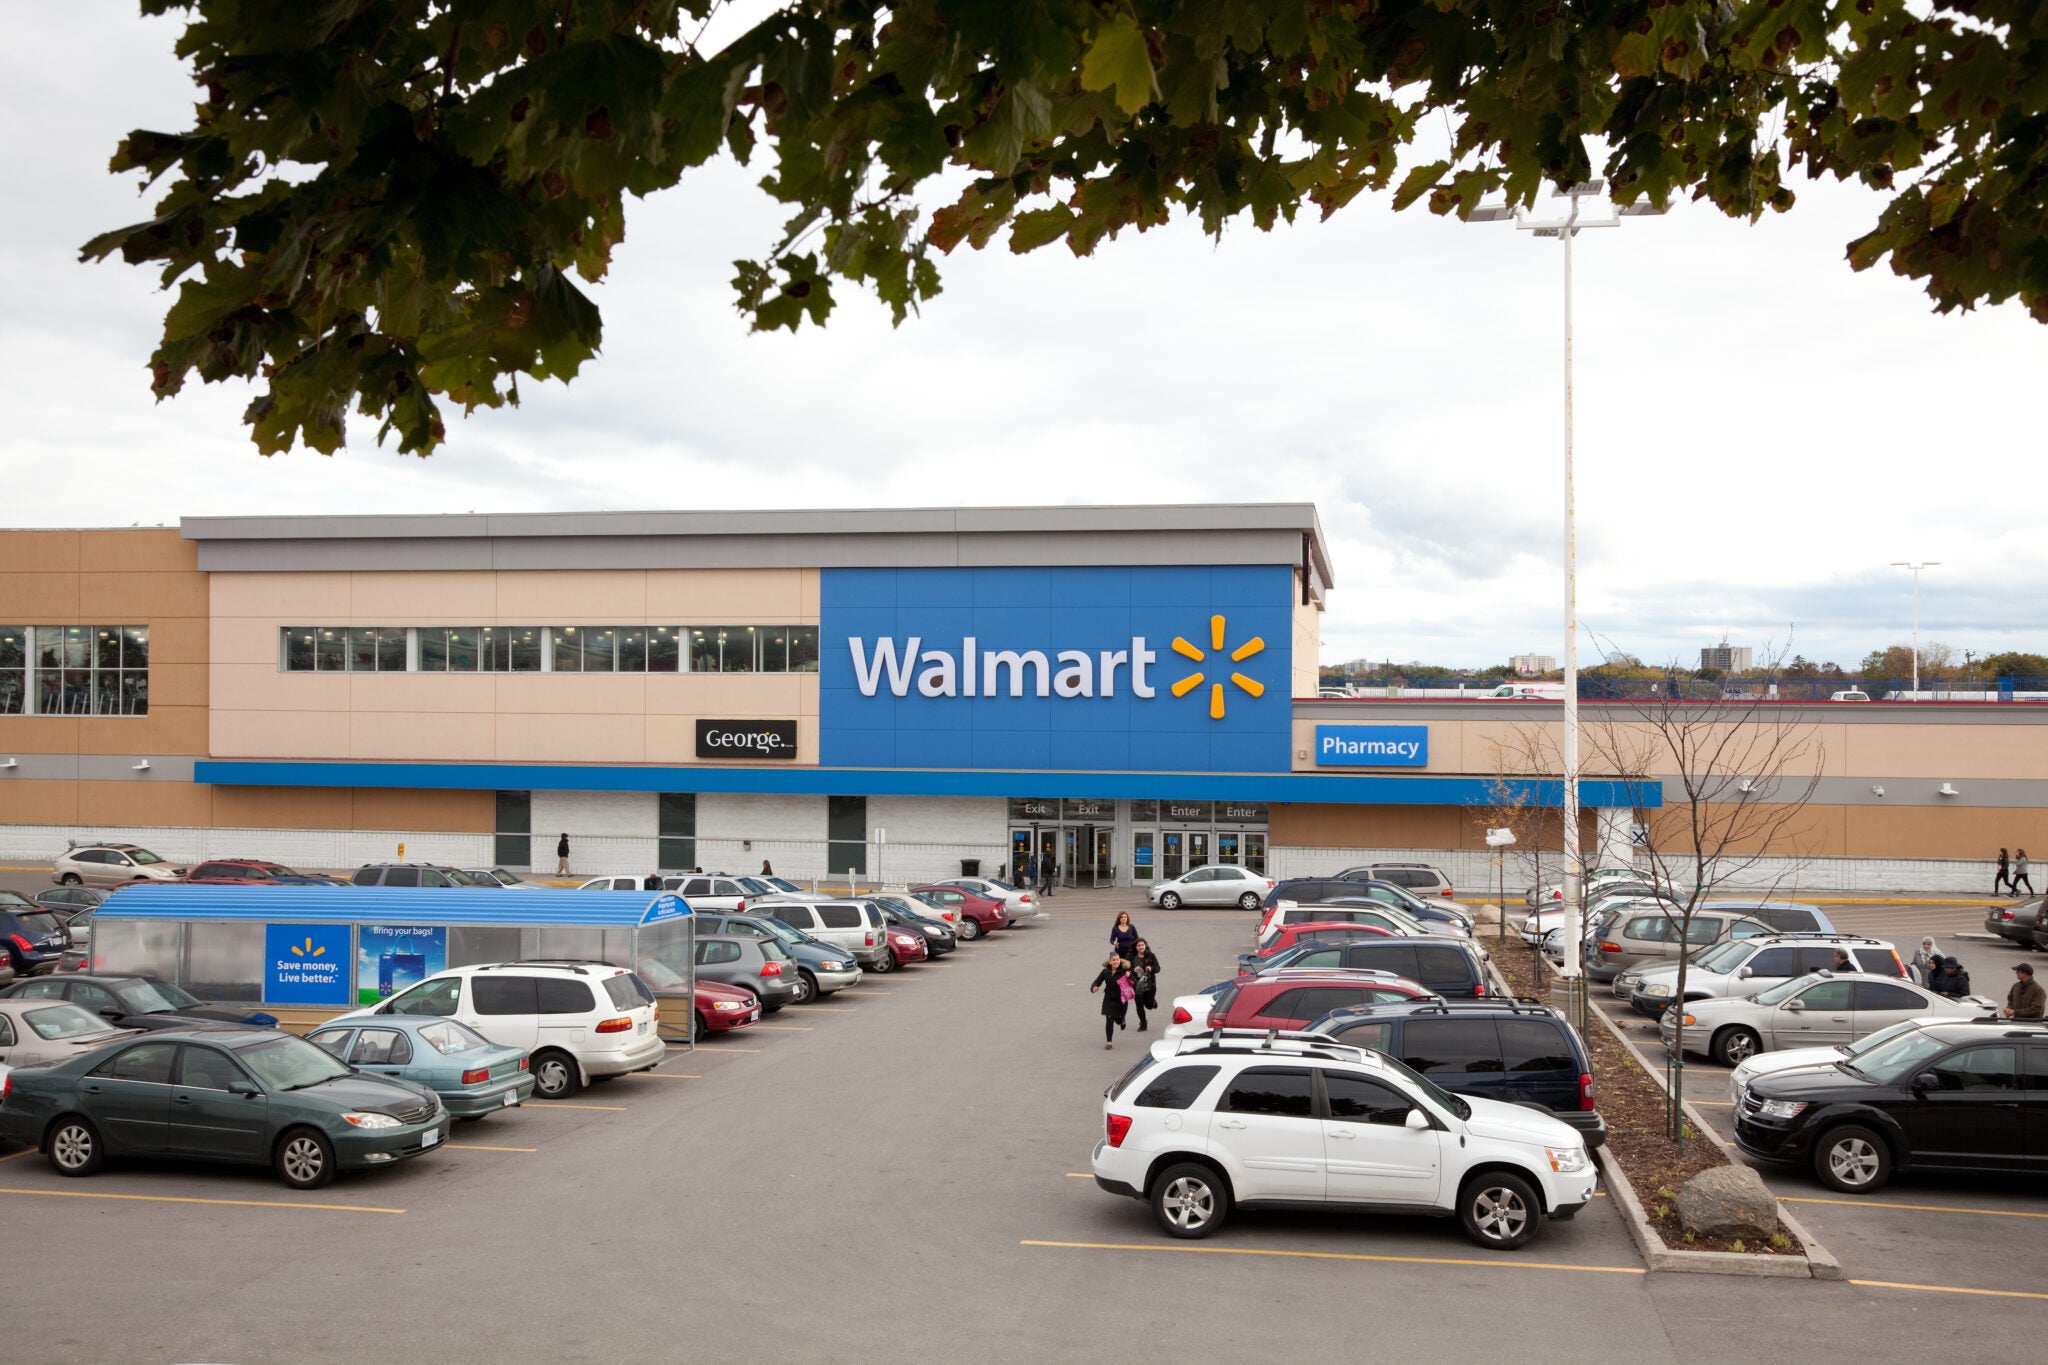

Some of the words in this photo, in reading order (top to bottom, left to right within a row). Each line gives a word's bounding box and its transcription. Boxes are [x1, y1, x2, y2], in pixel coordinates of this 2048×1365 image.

[848, 636, 1156, 698] Walmart
[1322, 736, 1420, 759] Pharmacy
[1025, 803, 1047, 814] Exit
[1078, 804, 1100, 815] Exit
[1171, 805, 1201, 817] Enter
[1226, 806, 1257, 817] Enter
[373, 926, 394, 937] Bring
[394, 928, 412, 937] your
[412, 926, 433, 938] bags!
[277, 960, 301, 970] Save
[302, 962, 339, 973] money.
[279, 972, 300, 983] Live
